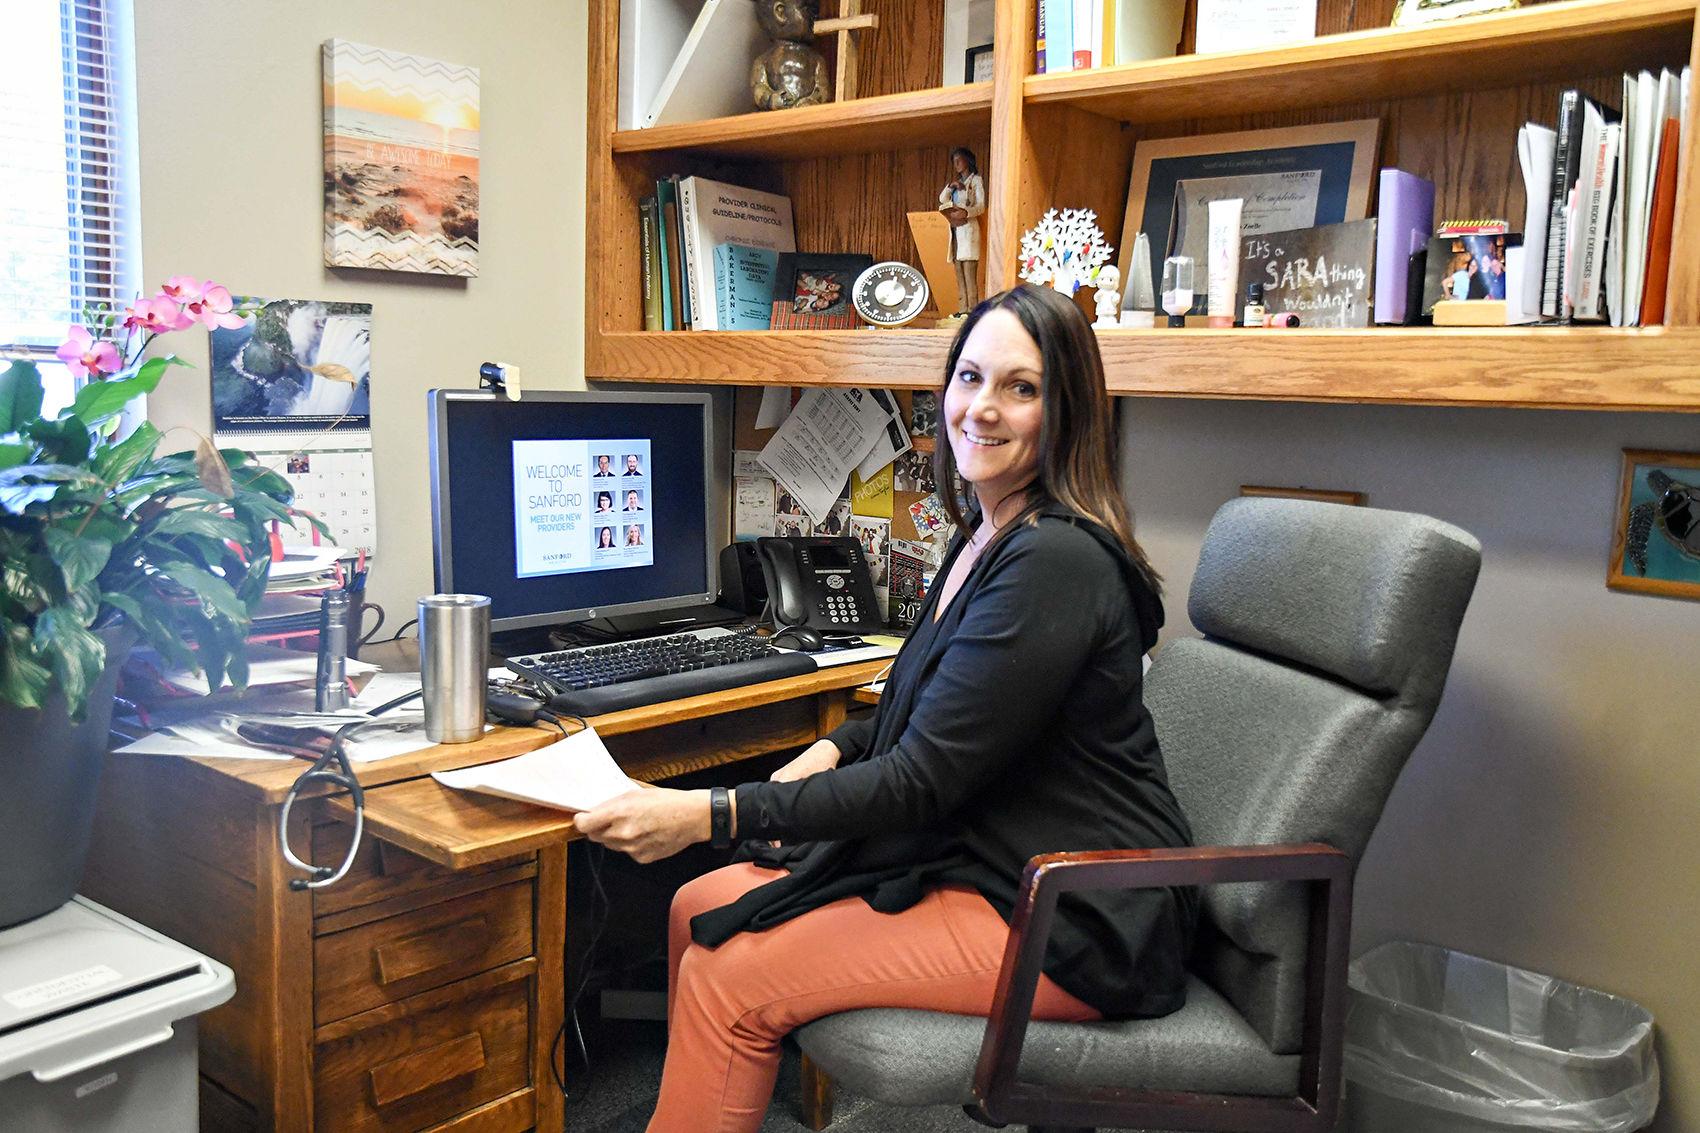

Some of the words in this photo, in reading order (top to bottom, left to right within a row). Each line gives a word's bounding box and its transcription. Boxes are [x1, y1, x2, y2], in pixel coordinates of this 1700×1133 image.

[718, 196, 748, 208] PROVIDER
[749, 202, 777, 214] CLINICAL
[1592, 190, 1600, 204] BIG
[712, 208, 782, 226] GUIDELINE/PROTOCOLS
[1590, 204, 1599, 225] BOOK
[1588, 226, 1596, 235] OF
[1245, 240, 1270, 259] It's
[1275, 247, 1285, 257] a
[1584, 237, 1597, 279] EXERCISES
[1263, 255, 1329, 291] SARA
[1329, 263, 1366, 290] thing
[526, 464, 583, 479] WELCOME
[548, 479, 562, 492] TO
[855, 473, 889, 504] PHOTOS
[529, 493, 582, 509] SANFORD
[530, 515, 549, 523] MEET
[550, 514, 564, 522] OUR
[565, 513, 582, 521] NEW
[538, 522, 575, 532] PROVIDERS
